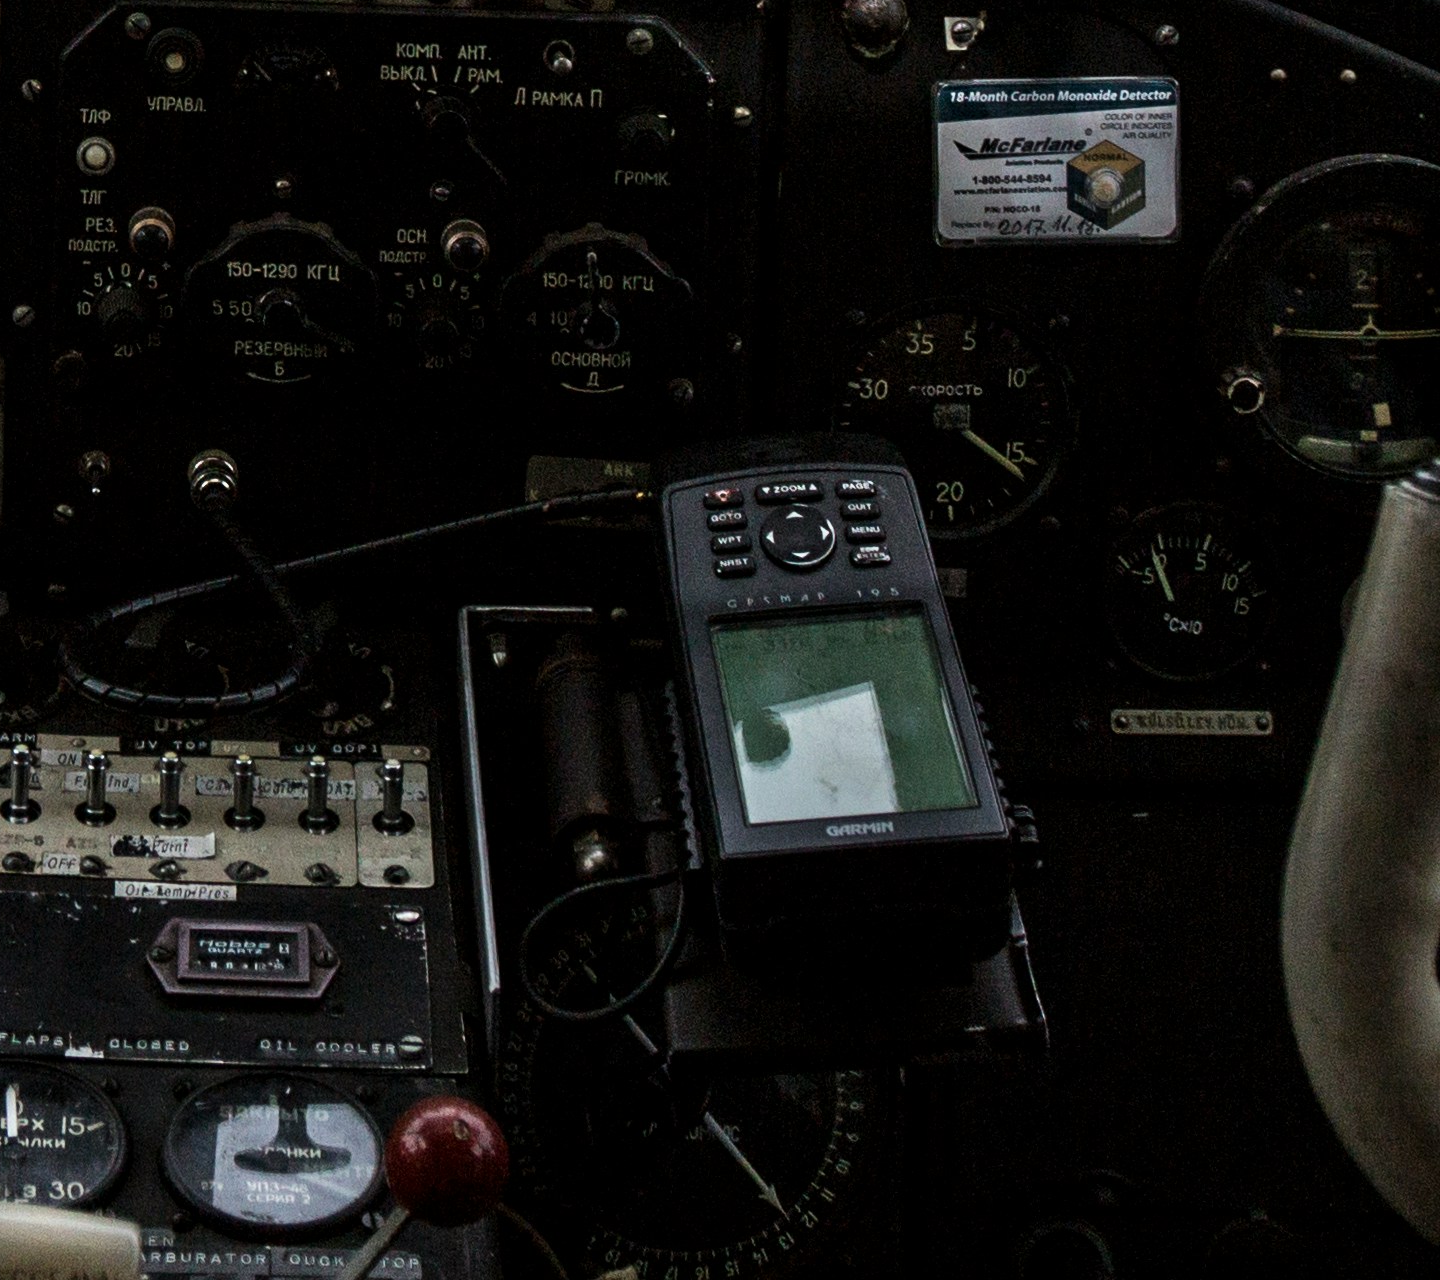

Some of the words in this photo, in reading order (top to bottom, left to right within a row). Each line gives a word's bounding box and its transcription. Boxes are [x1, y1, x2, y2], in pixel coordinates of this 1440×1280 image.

[396, 42, 443, 60] КОМП.
[457, 43, 492, 61] АНТ.
[147, 95, 207, 113] УПРАВЛ.
[532, 89, 583, 108] РАМКА
[950, 90, 1009, 103] 18-Month
[1010, 90, 1056, 102] Carbon
[1057, 89, 1118, 102] Monoxide
[1120, 88, 1172, 101] Detector
[79, 107, 112, 125] ТЛФ
[981, 137, 1088, 154] McFarlane
[614, 169, 671, 187] ГРОМК.
[972, 174, 1052, 186] 1-800-544-8594
[79, 189, 108, 205] ТЛГ
[84, 216, 118, 234] РЕЗ.
[67, 238, 119, 254] ПОДСТР.
[226, 261, 298, 279] 150-1290
[306, 263, 340, 283] КГЦ
[622, 274, 654, 293] КГЦ
[550, 350, 632, 369] ОСНОВНОЙ
[774, 484, 806, 493] ZOOM
[0, 732, 37, 743] ARM
[172, 741, 208, 752] TOP
[825, 820, 895, 837] GARMIN
[259, 1038, 298, 1052] OIL
[315, 1041, 397, 1056] COOLER
[48, 1179, 86, 1200] 30
